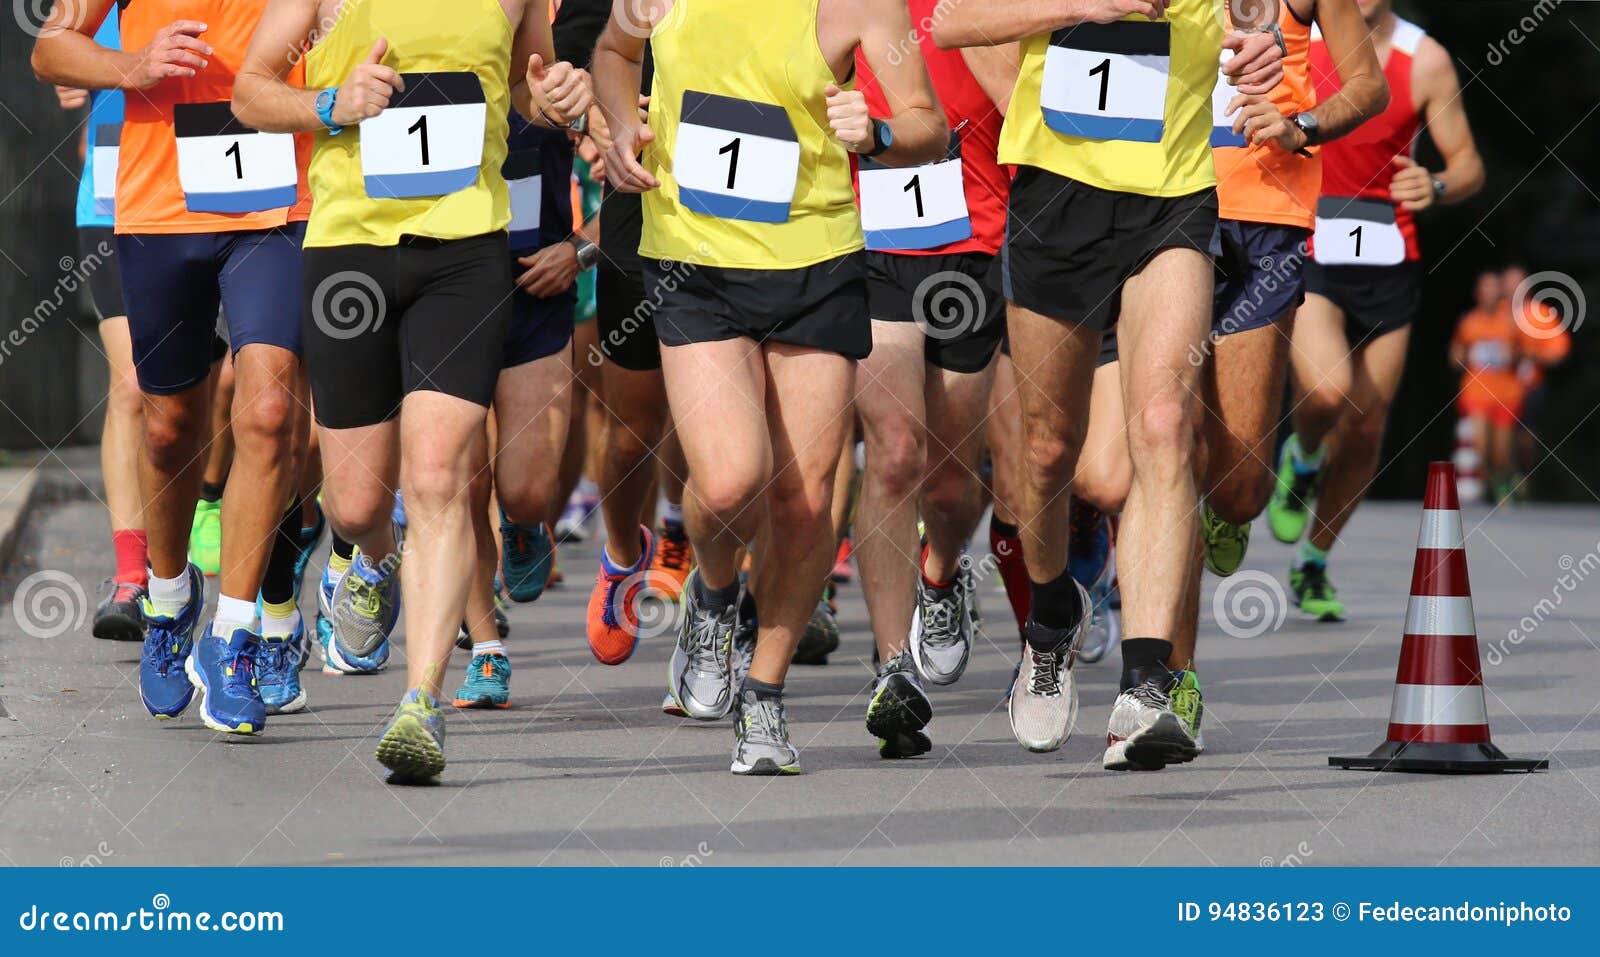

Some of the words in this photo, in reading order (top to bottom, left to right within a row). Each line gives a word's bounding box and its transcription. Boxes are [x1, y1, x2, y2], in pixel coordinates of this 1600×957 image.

[1088, 58, 1111, 111] 1
[225, 141, 243, 180] 1
[407, 114, 430, 166] 1
[718, 137, 741, 190] 1
[903, 174, 924, 218] 1
[1349, 225, 1362, 257] 1
